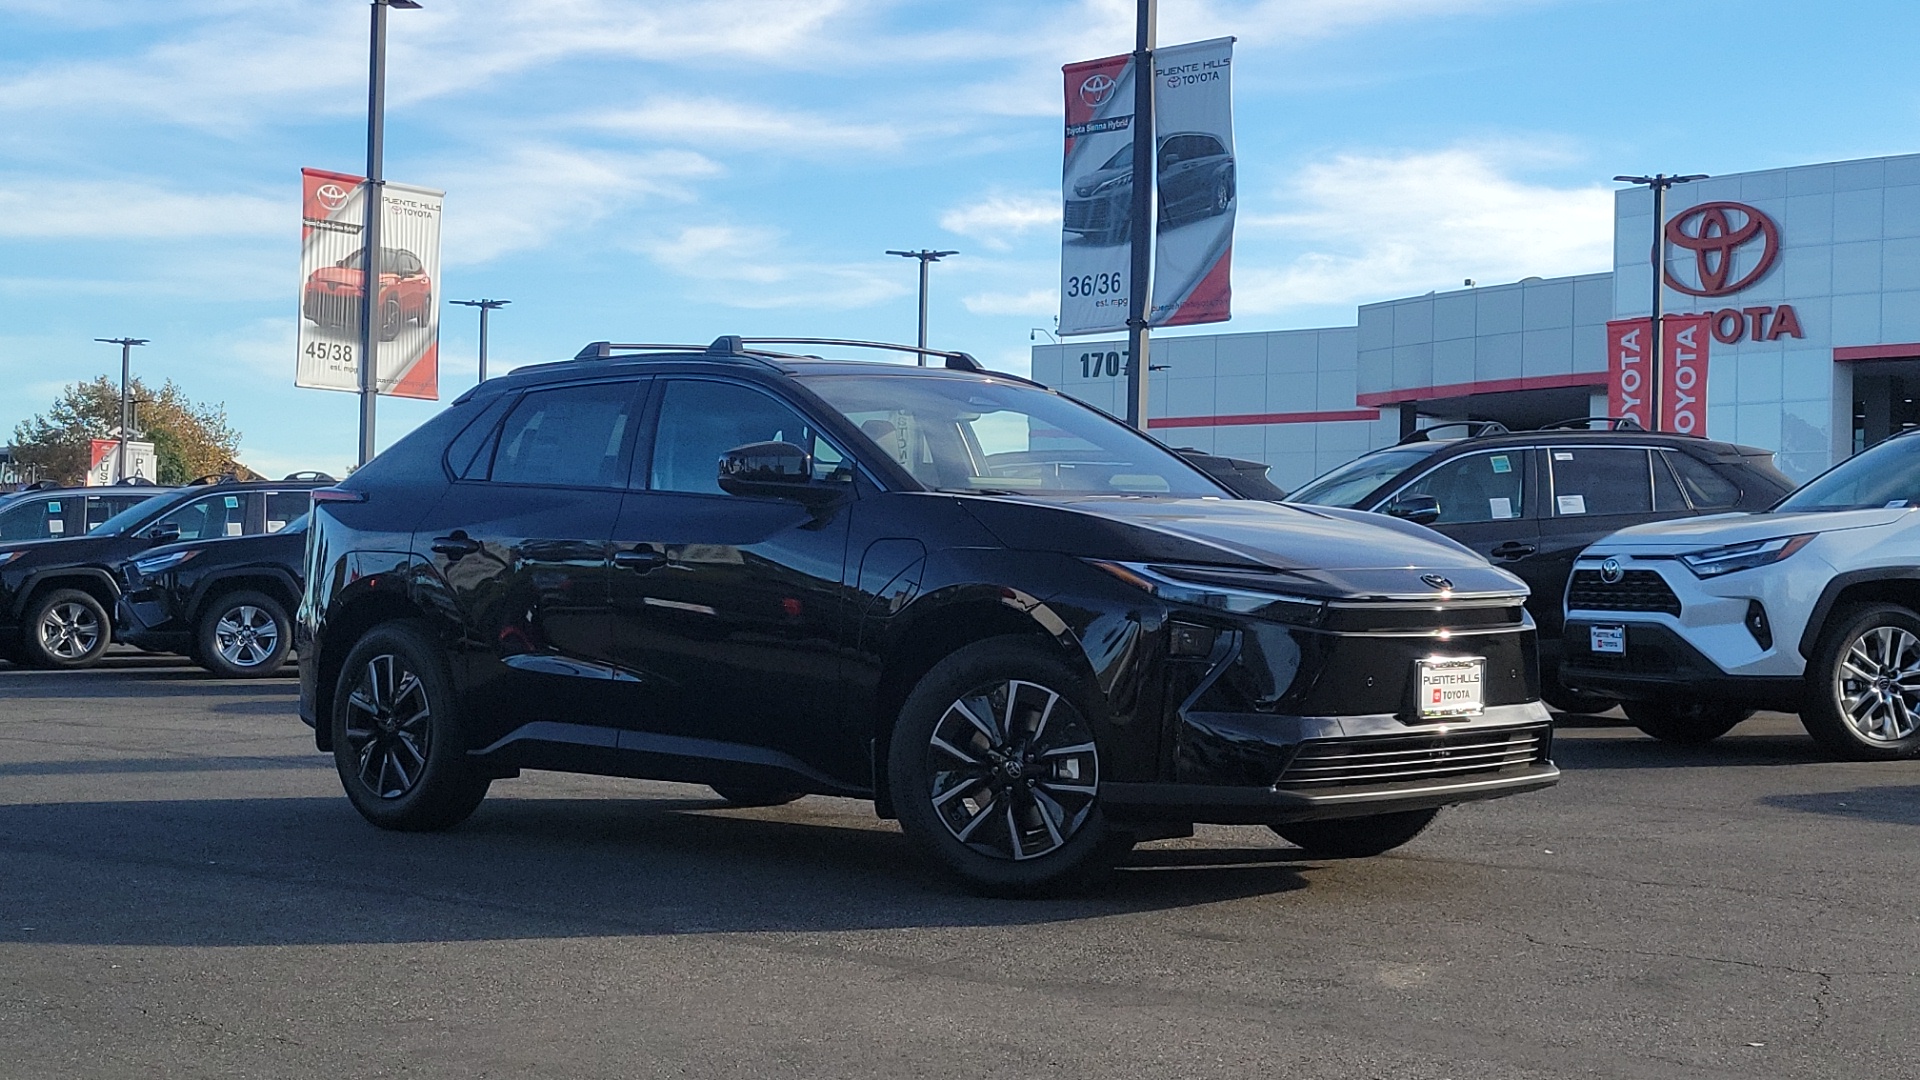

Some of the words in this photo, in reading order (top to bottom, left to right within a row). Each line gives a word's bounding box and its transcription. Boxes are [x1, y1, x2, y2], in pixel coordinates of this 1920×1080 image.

[1155, 63, 1199, 77] PUENTE
[1203, 57, 1231, 70] HILLS
[1182, 71, 1220, 85] TOYOTA
[1066, 126, 1085, 136] Toyota
[1108, 118, 1128, 130] Hybrid
[382, 196, 418, 208] PUENTE
[420, 203, 442, 212] HILLS
[403, 207, 433, 220] TOYOTA
[1067, 271, 1121, 298] 36/36
[1111, 297, 1128, 308] mpg
[305, 341, 352, 362] 45/38
[1423, 674, 1455, 686] PUENTE
[1456, 673, 1480, 684] HILLS
[1443, 690, 1470, 700] TOYOTA
